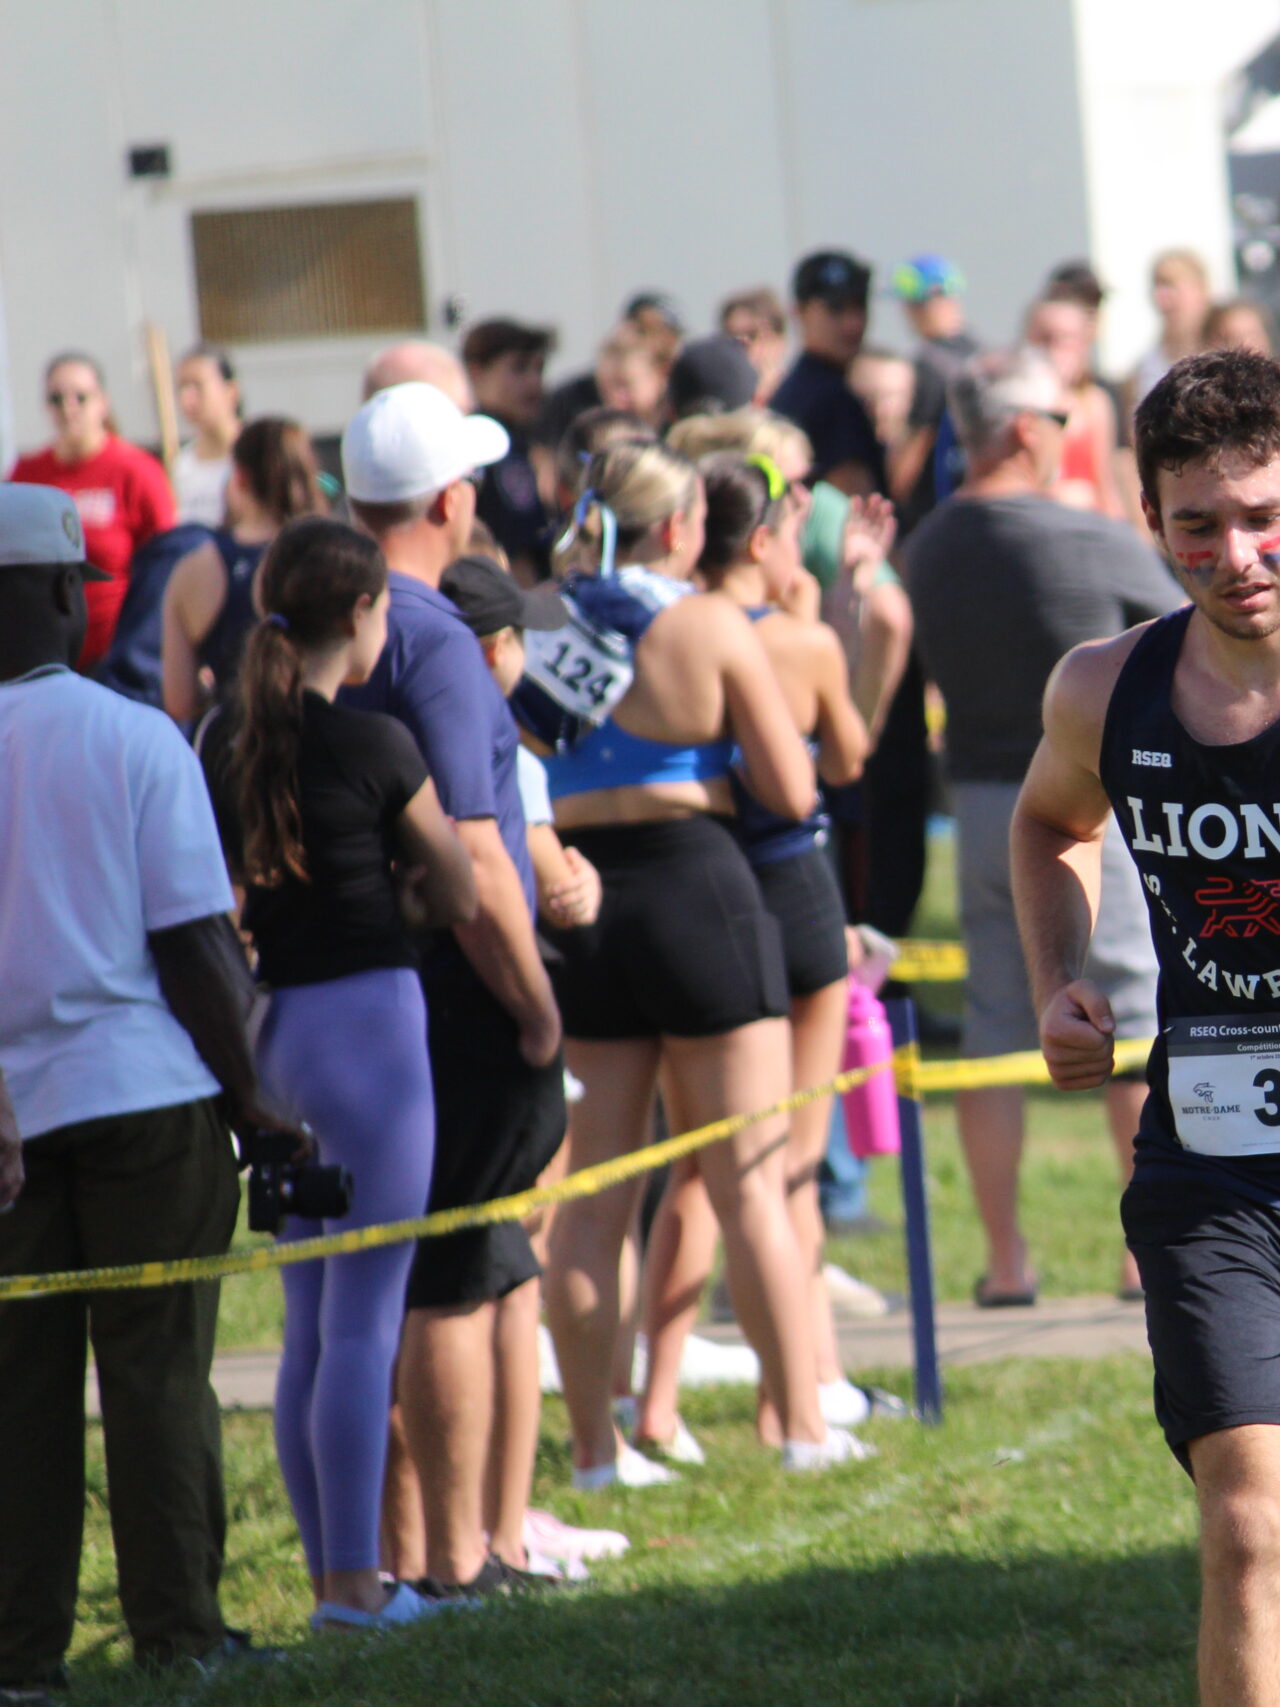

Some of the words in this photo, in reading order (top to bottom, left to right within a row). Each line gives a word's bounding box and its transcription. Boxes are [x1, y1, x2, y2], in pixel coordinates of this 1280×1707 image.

[544, 641, 617, 706] 124
[1132, 749, 1172, 767] RSEQ
[1190, 1026, 1217, 1037] RSEQ
[1182, 1104, 1241, 1115] NOTRE-DAME
